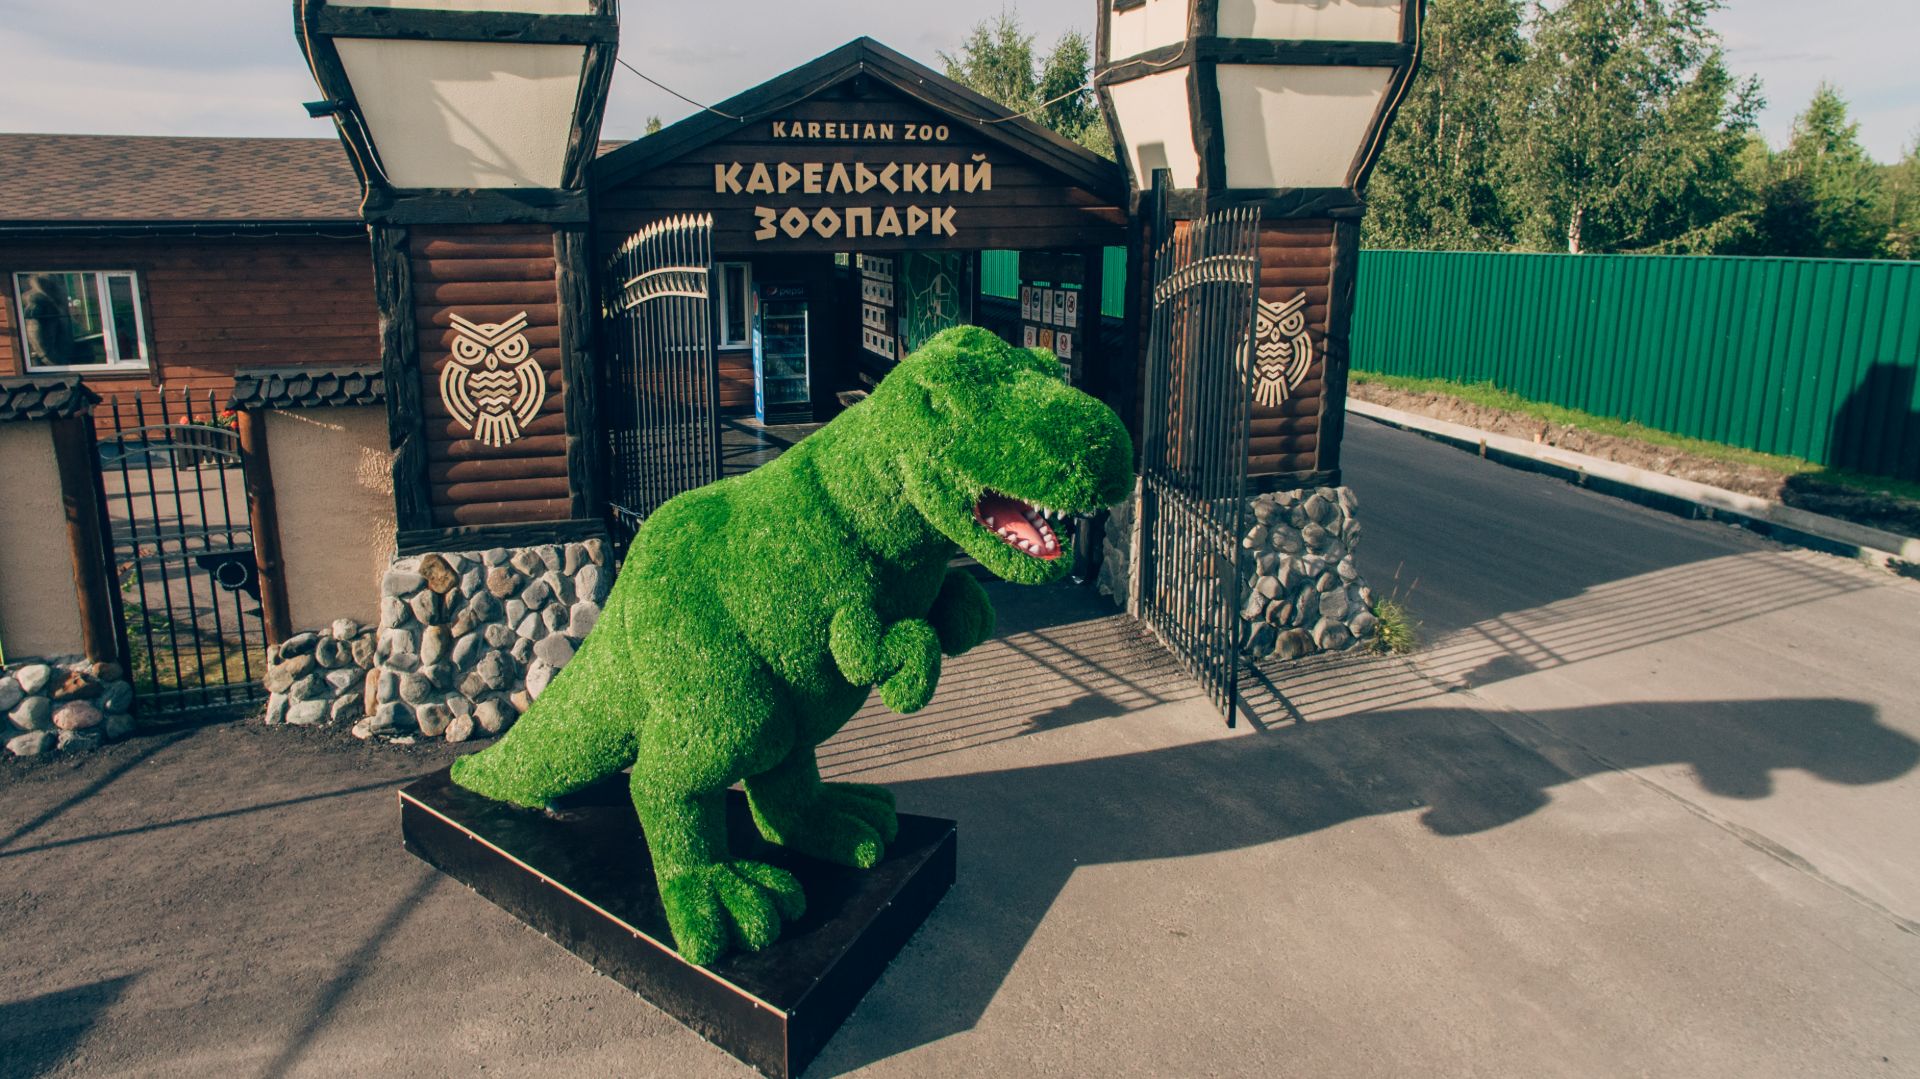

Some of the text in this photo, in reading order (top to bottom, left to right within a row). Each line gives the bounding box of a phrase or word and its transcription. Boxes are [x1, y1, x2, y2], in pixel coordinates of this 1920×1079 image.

[773, 121, 950, 140] KARELIAN ZOO
[715, 154, 992, 194] КАРЕЛЬСКИЙ
[754, 205, 958, 241] ЗООПАРК
[779, 287, 804, 296] pepsi
